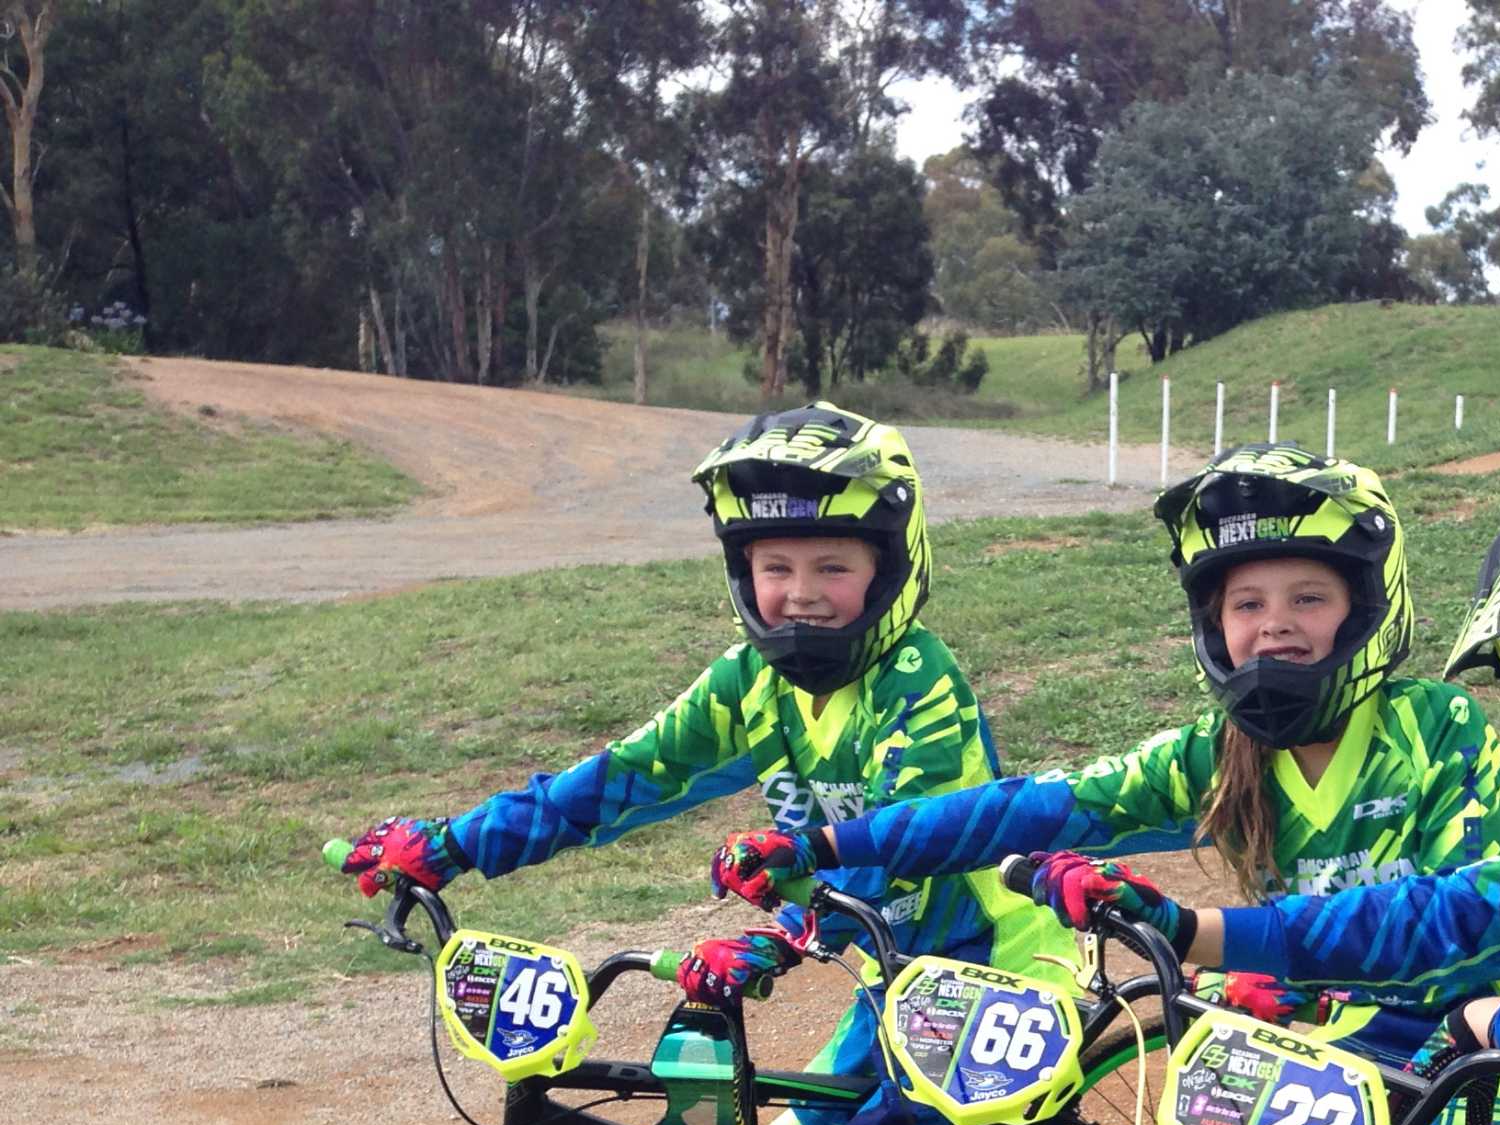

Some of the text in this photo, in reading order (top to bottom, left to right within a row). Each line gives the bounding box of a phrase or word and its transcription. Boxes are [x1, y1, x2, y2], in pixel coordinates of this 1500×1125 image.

[1219, 518, 1289, 544] NEXTGEN
[1353, 792, 1408, 820] DK
[489, 938, 536, 955] BOX
[960, 966, 1024, 988] BOX
[500, 967, 568, 1030] 46
[970, 1001, 1055, 1071] 66
[1252, 1027, 1327, 1062] BOX
[506, 1045, 534, 1058] Jayco
[1228, 1055, 1280, 1082] NEXTGEN
[1221, 1074, 1259, 1090] DK
[970, 1088, 1007, 1101] Jayco
[1221, 1090, 1256, 1104] BOX
